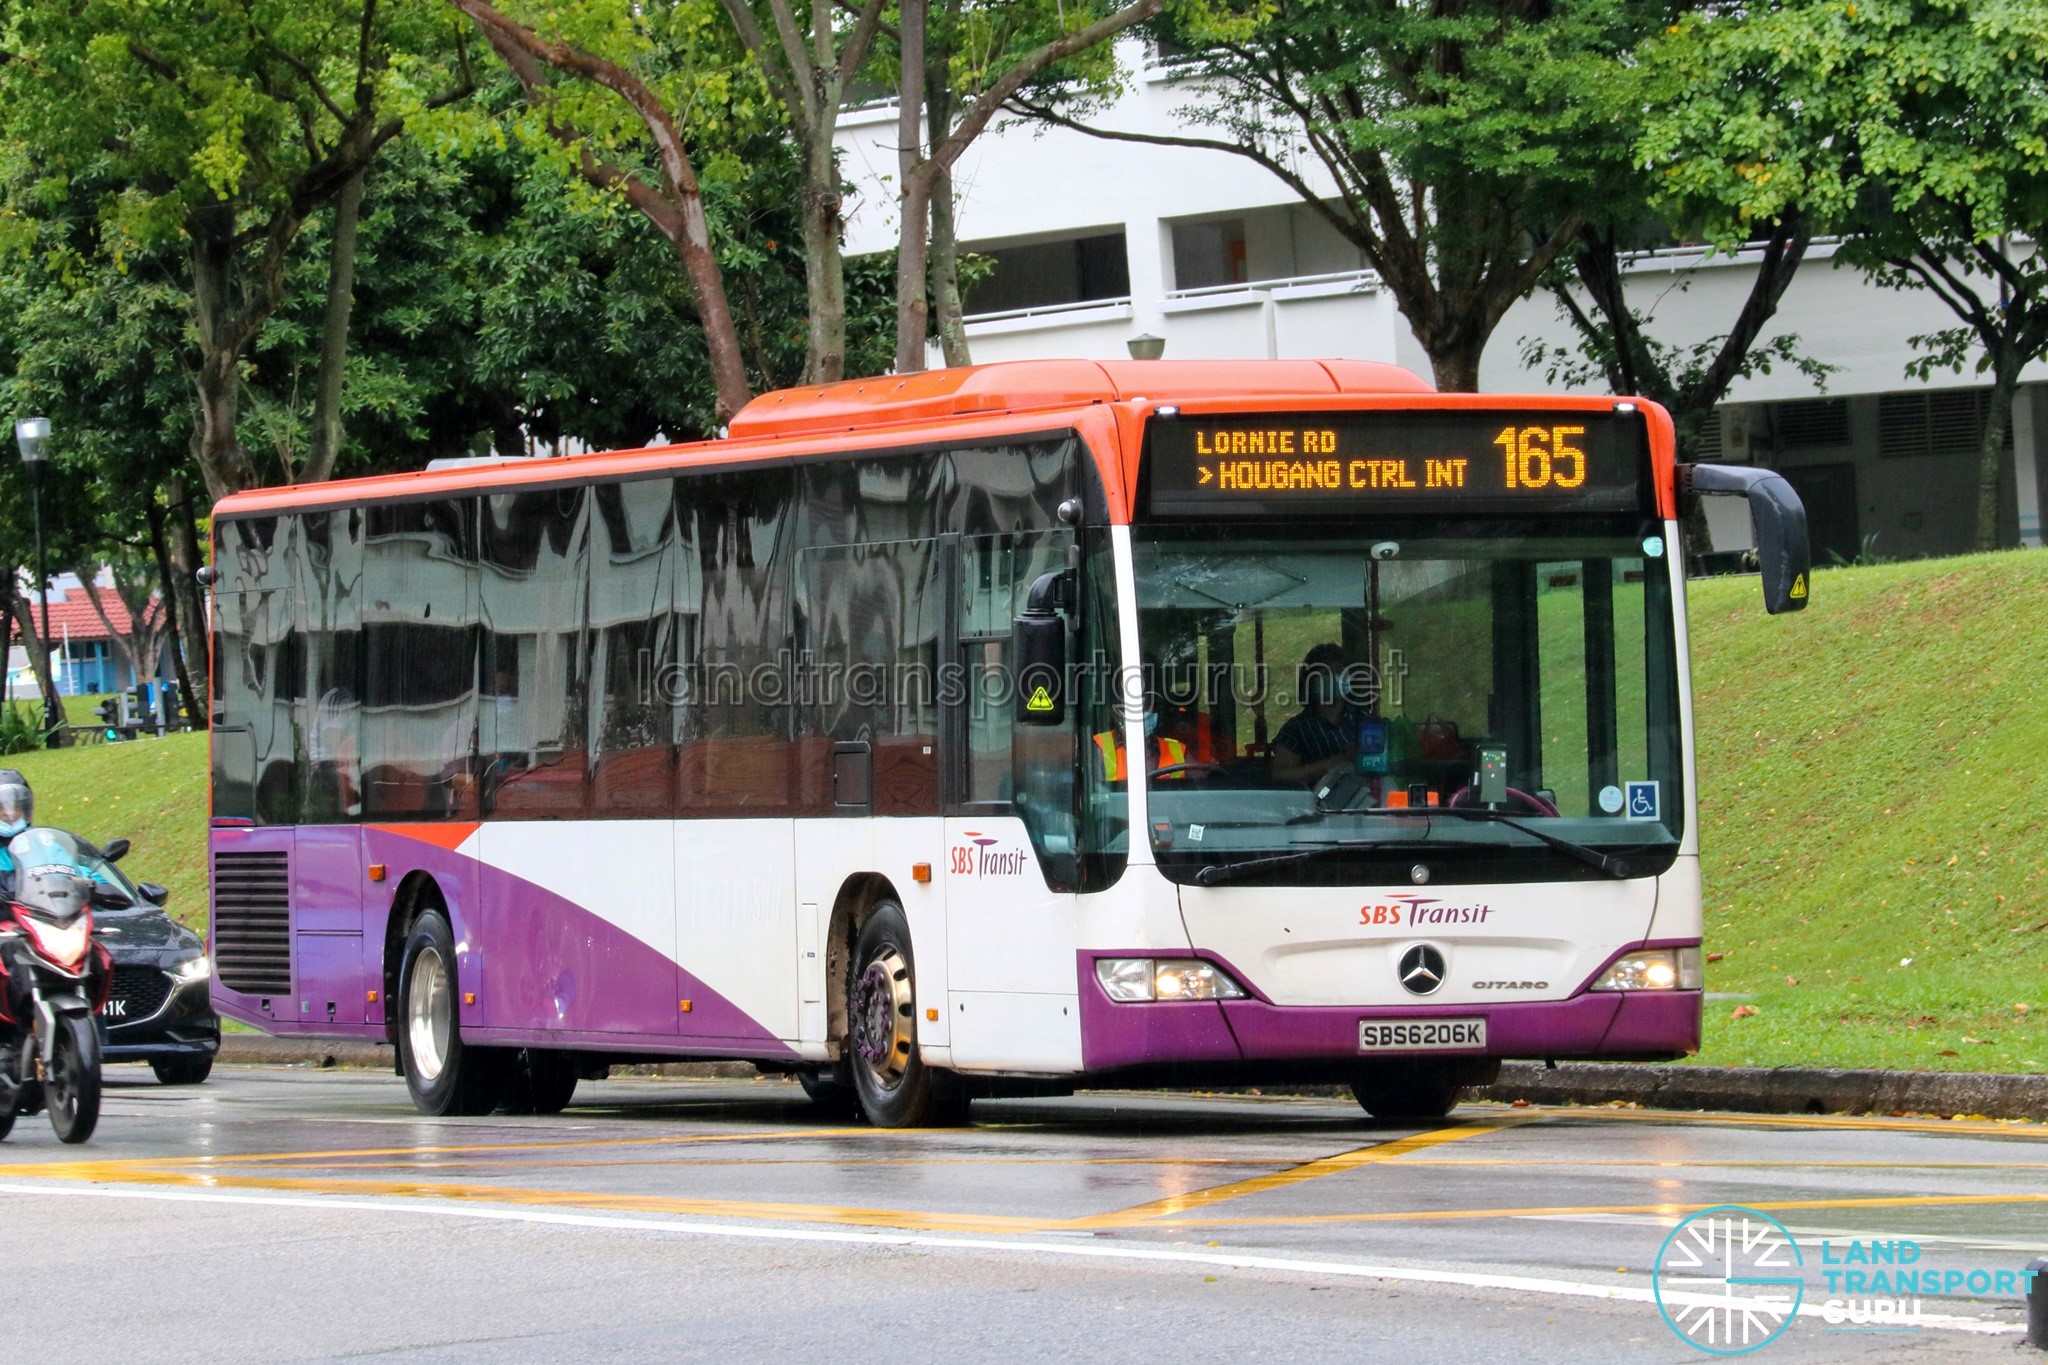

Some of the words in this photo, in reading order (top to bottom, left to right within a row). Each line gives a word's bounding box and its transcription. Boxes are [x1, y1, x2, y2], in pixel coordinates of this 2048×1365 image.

[1196, 431, 1294, 454] LORNIE
[1303, 431, 1336, 453] RD
[1494, 426, 1585, 488] 165
[1219, 461, 1340, 489] HOUGANG
[1349, 460, 1416, 488] CTRL
[1425, 459, 1467, 487] INT
[951, 847, 973, 875] SBS
[972, 839, 1028, 880] Transit
[1359, 905, 1401, 925] SBS
[1399, 899, 1496, 928] Transit
[1472, 981, 1549, 990] CITARO
[1363, 1024, 1481, 1046] SBS6206K
